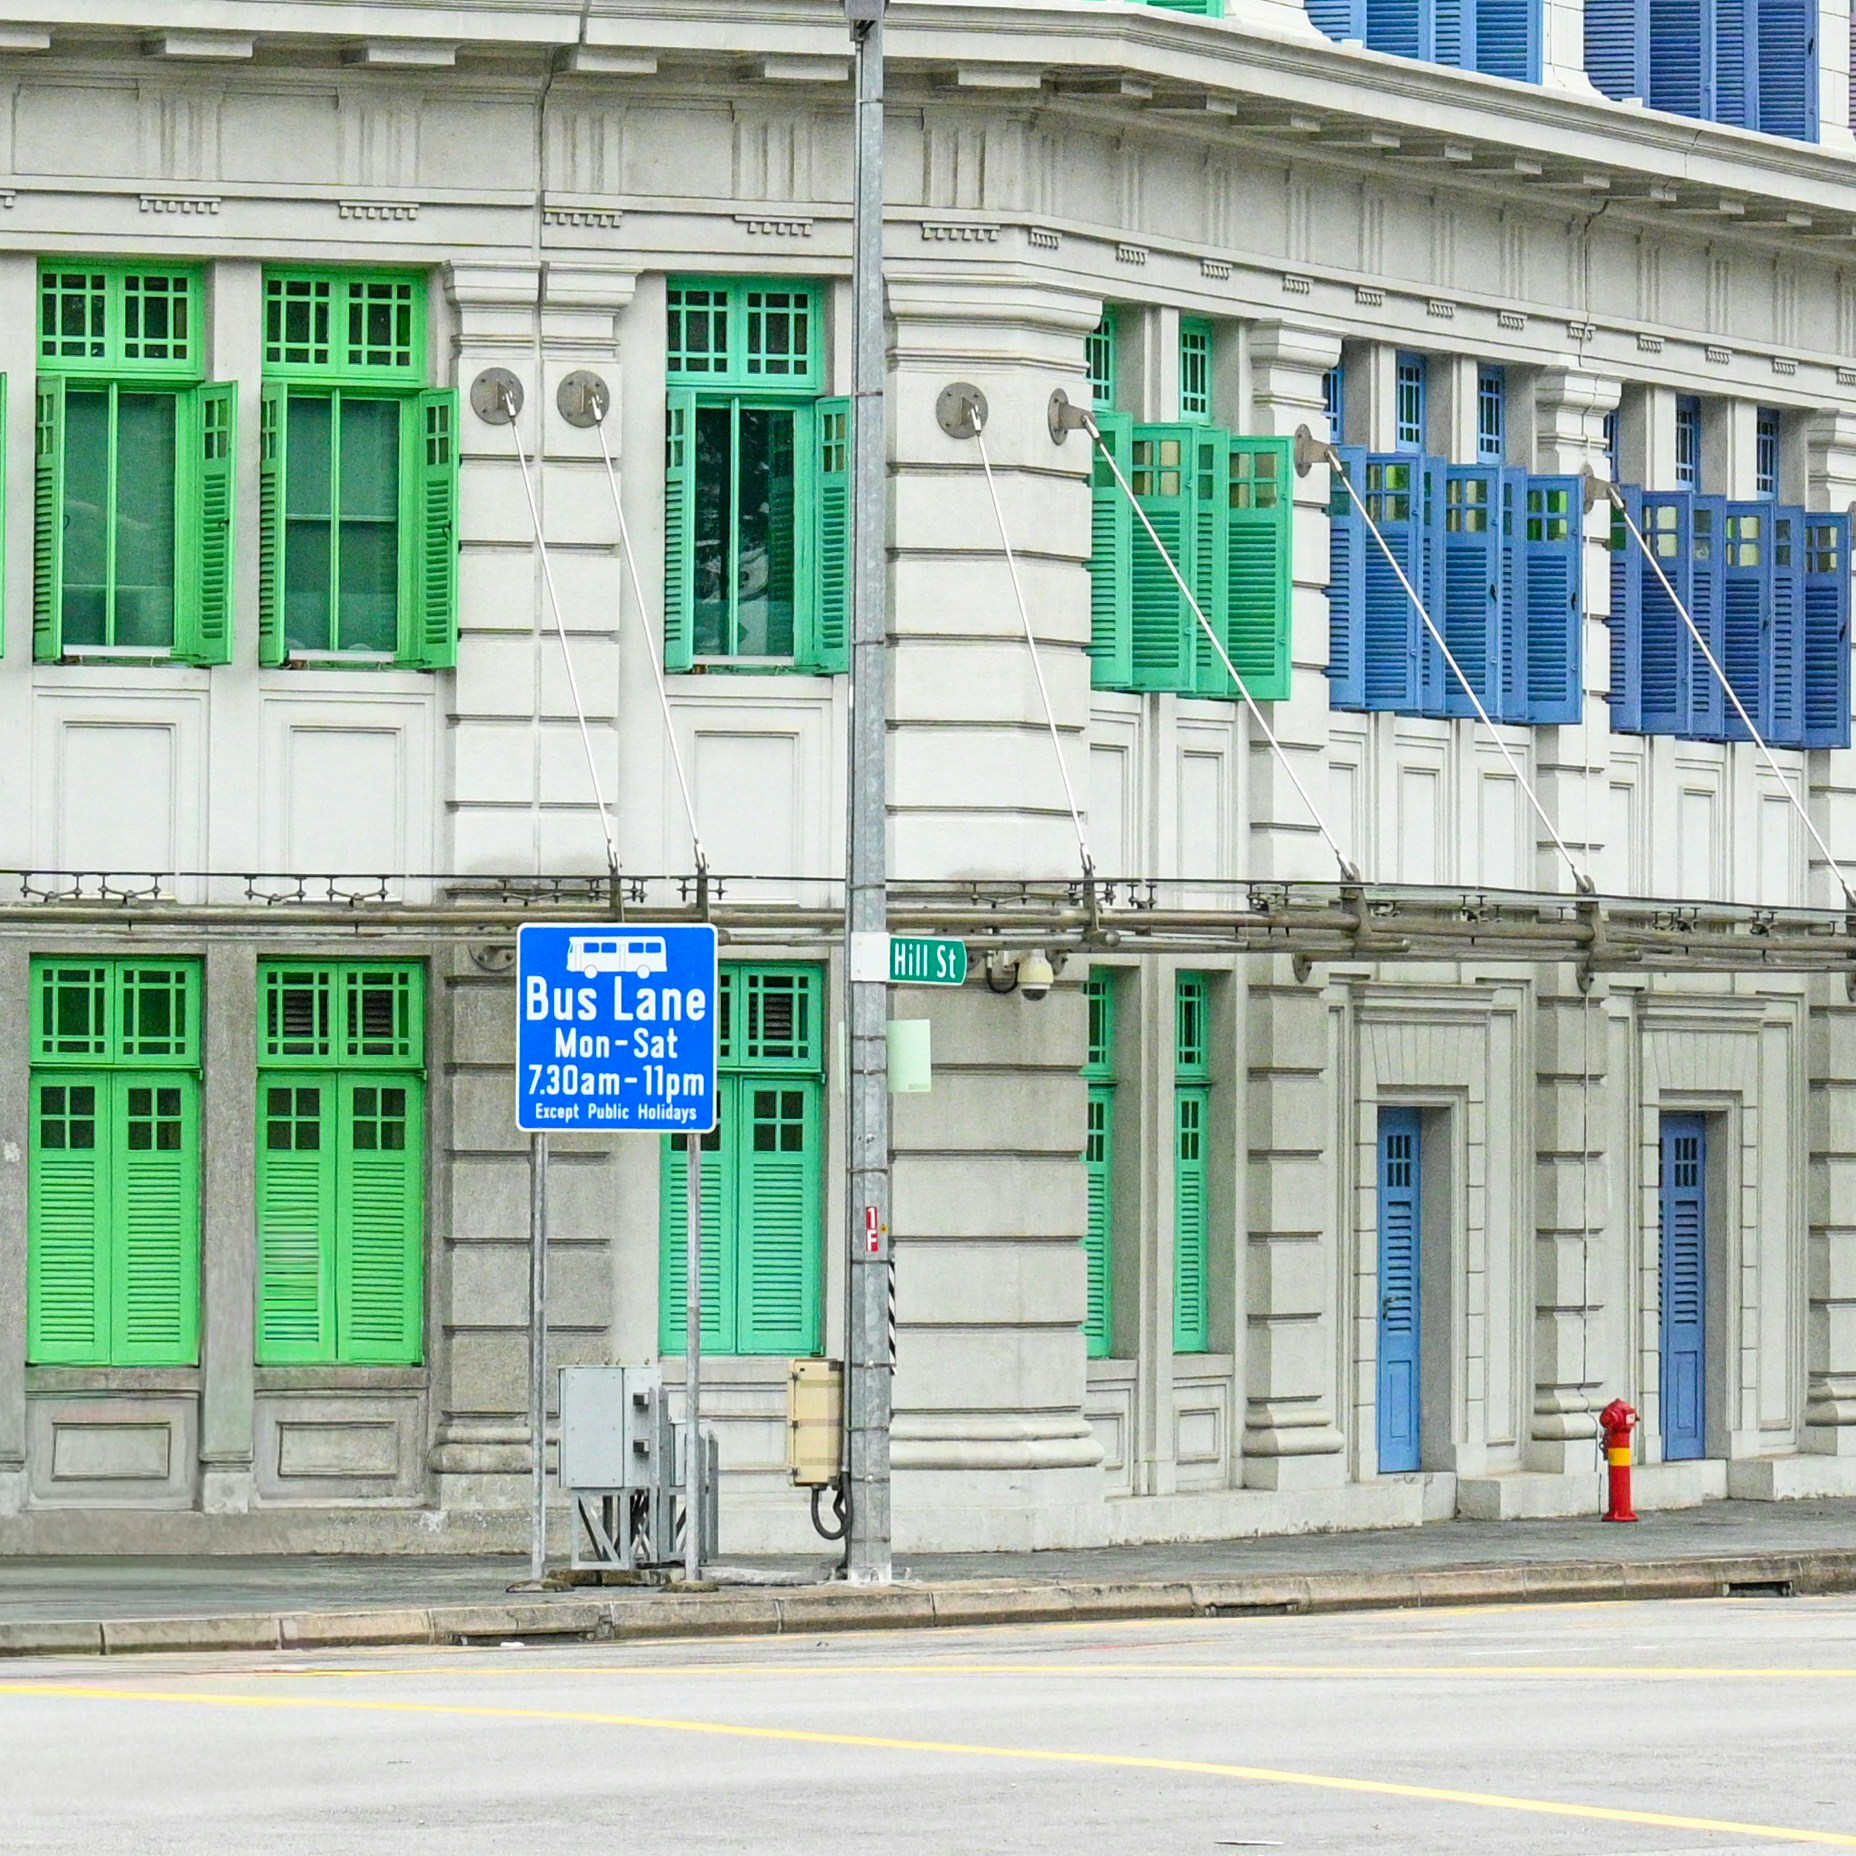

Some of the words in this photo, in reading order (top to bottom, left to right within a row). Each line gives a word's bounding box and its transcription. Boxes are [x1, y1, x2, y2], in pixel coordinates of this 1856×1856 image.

[894, 943, 928, 977] Hill
[936, 944, 956, 979] St
[526, 975, 598, 1021] Bus
[614, 975, 706, 1021] Lane
[555, 1027, 678, 1059] Mon-Sat
[529, 1064, 705, 1104] 7.30am-11pm
[535, 1102, 579, 1124] Except
[588, 1102, 630, 1120] Public
[637, 1103, 697, 1124] Holidays
